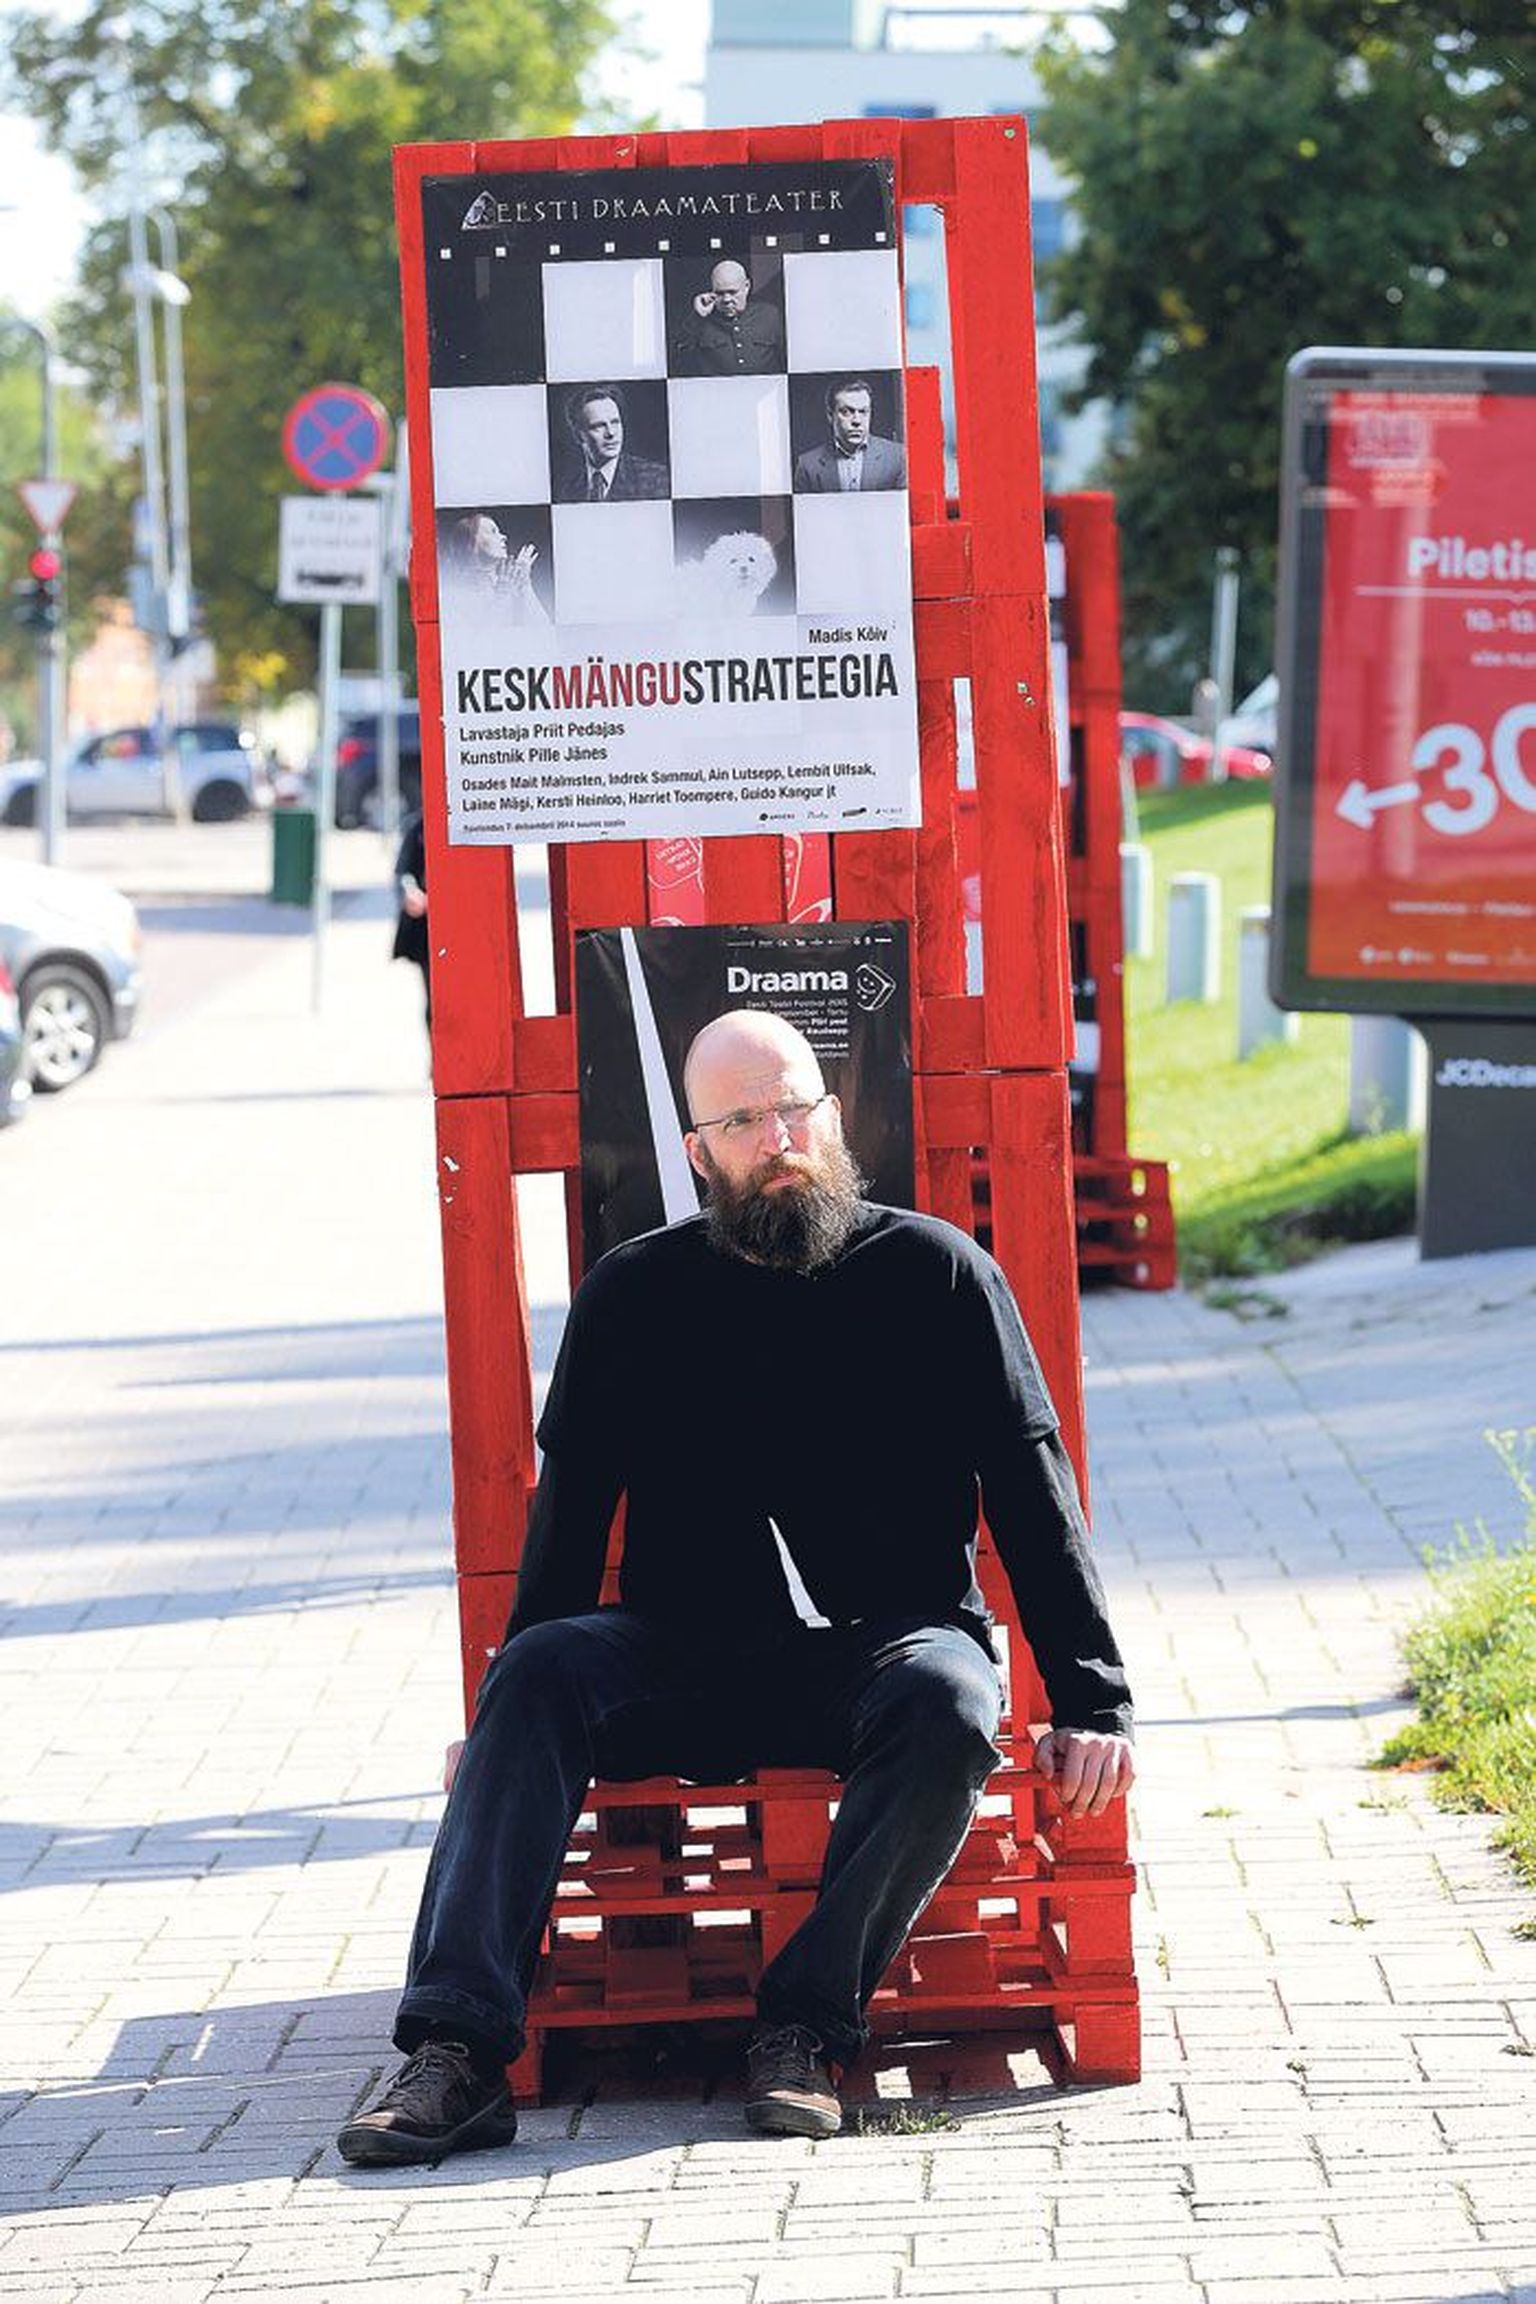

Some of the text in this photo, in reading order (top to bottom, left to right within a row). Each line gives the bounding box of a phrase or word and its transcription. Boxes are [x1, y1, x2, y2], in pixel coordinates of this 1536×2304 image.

[496, 190, 844, 224] EESTI DRAAMATEATER
[808, 625, 888, 644] Madis Kõiv
[457, 653, 899, 714] KESKMÄNGUSTRATEEGIA
[459, 721, 625, 742] Lavastaja Priit Pedajas
[460, 745, 608, 766] Kunstnik Pille Jänes
[461, 762, 876, 791] Osades Mait Malmsten, Indrek Sammul, Ain Lutsepp, Lembit Ulfsak,
[462, 798, 496, 812] Laine
[499, 796, 534, 813] Mägi,
[536, 794, 574, 808] Kersti
[629, 790, 671, 804] Harriet
[674, 788, 738, 805] Toompere,
[740, 786, 776, 800] Guido
[778, 784, 824, 802] Kangur
[826, 784, 837, 800] jt
[726, 965, 849, 993] Draama
